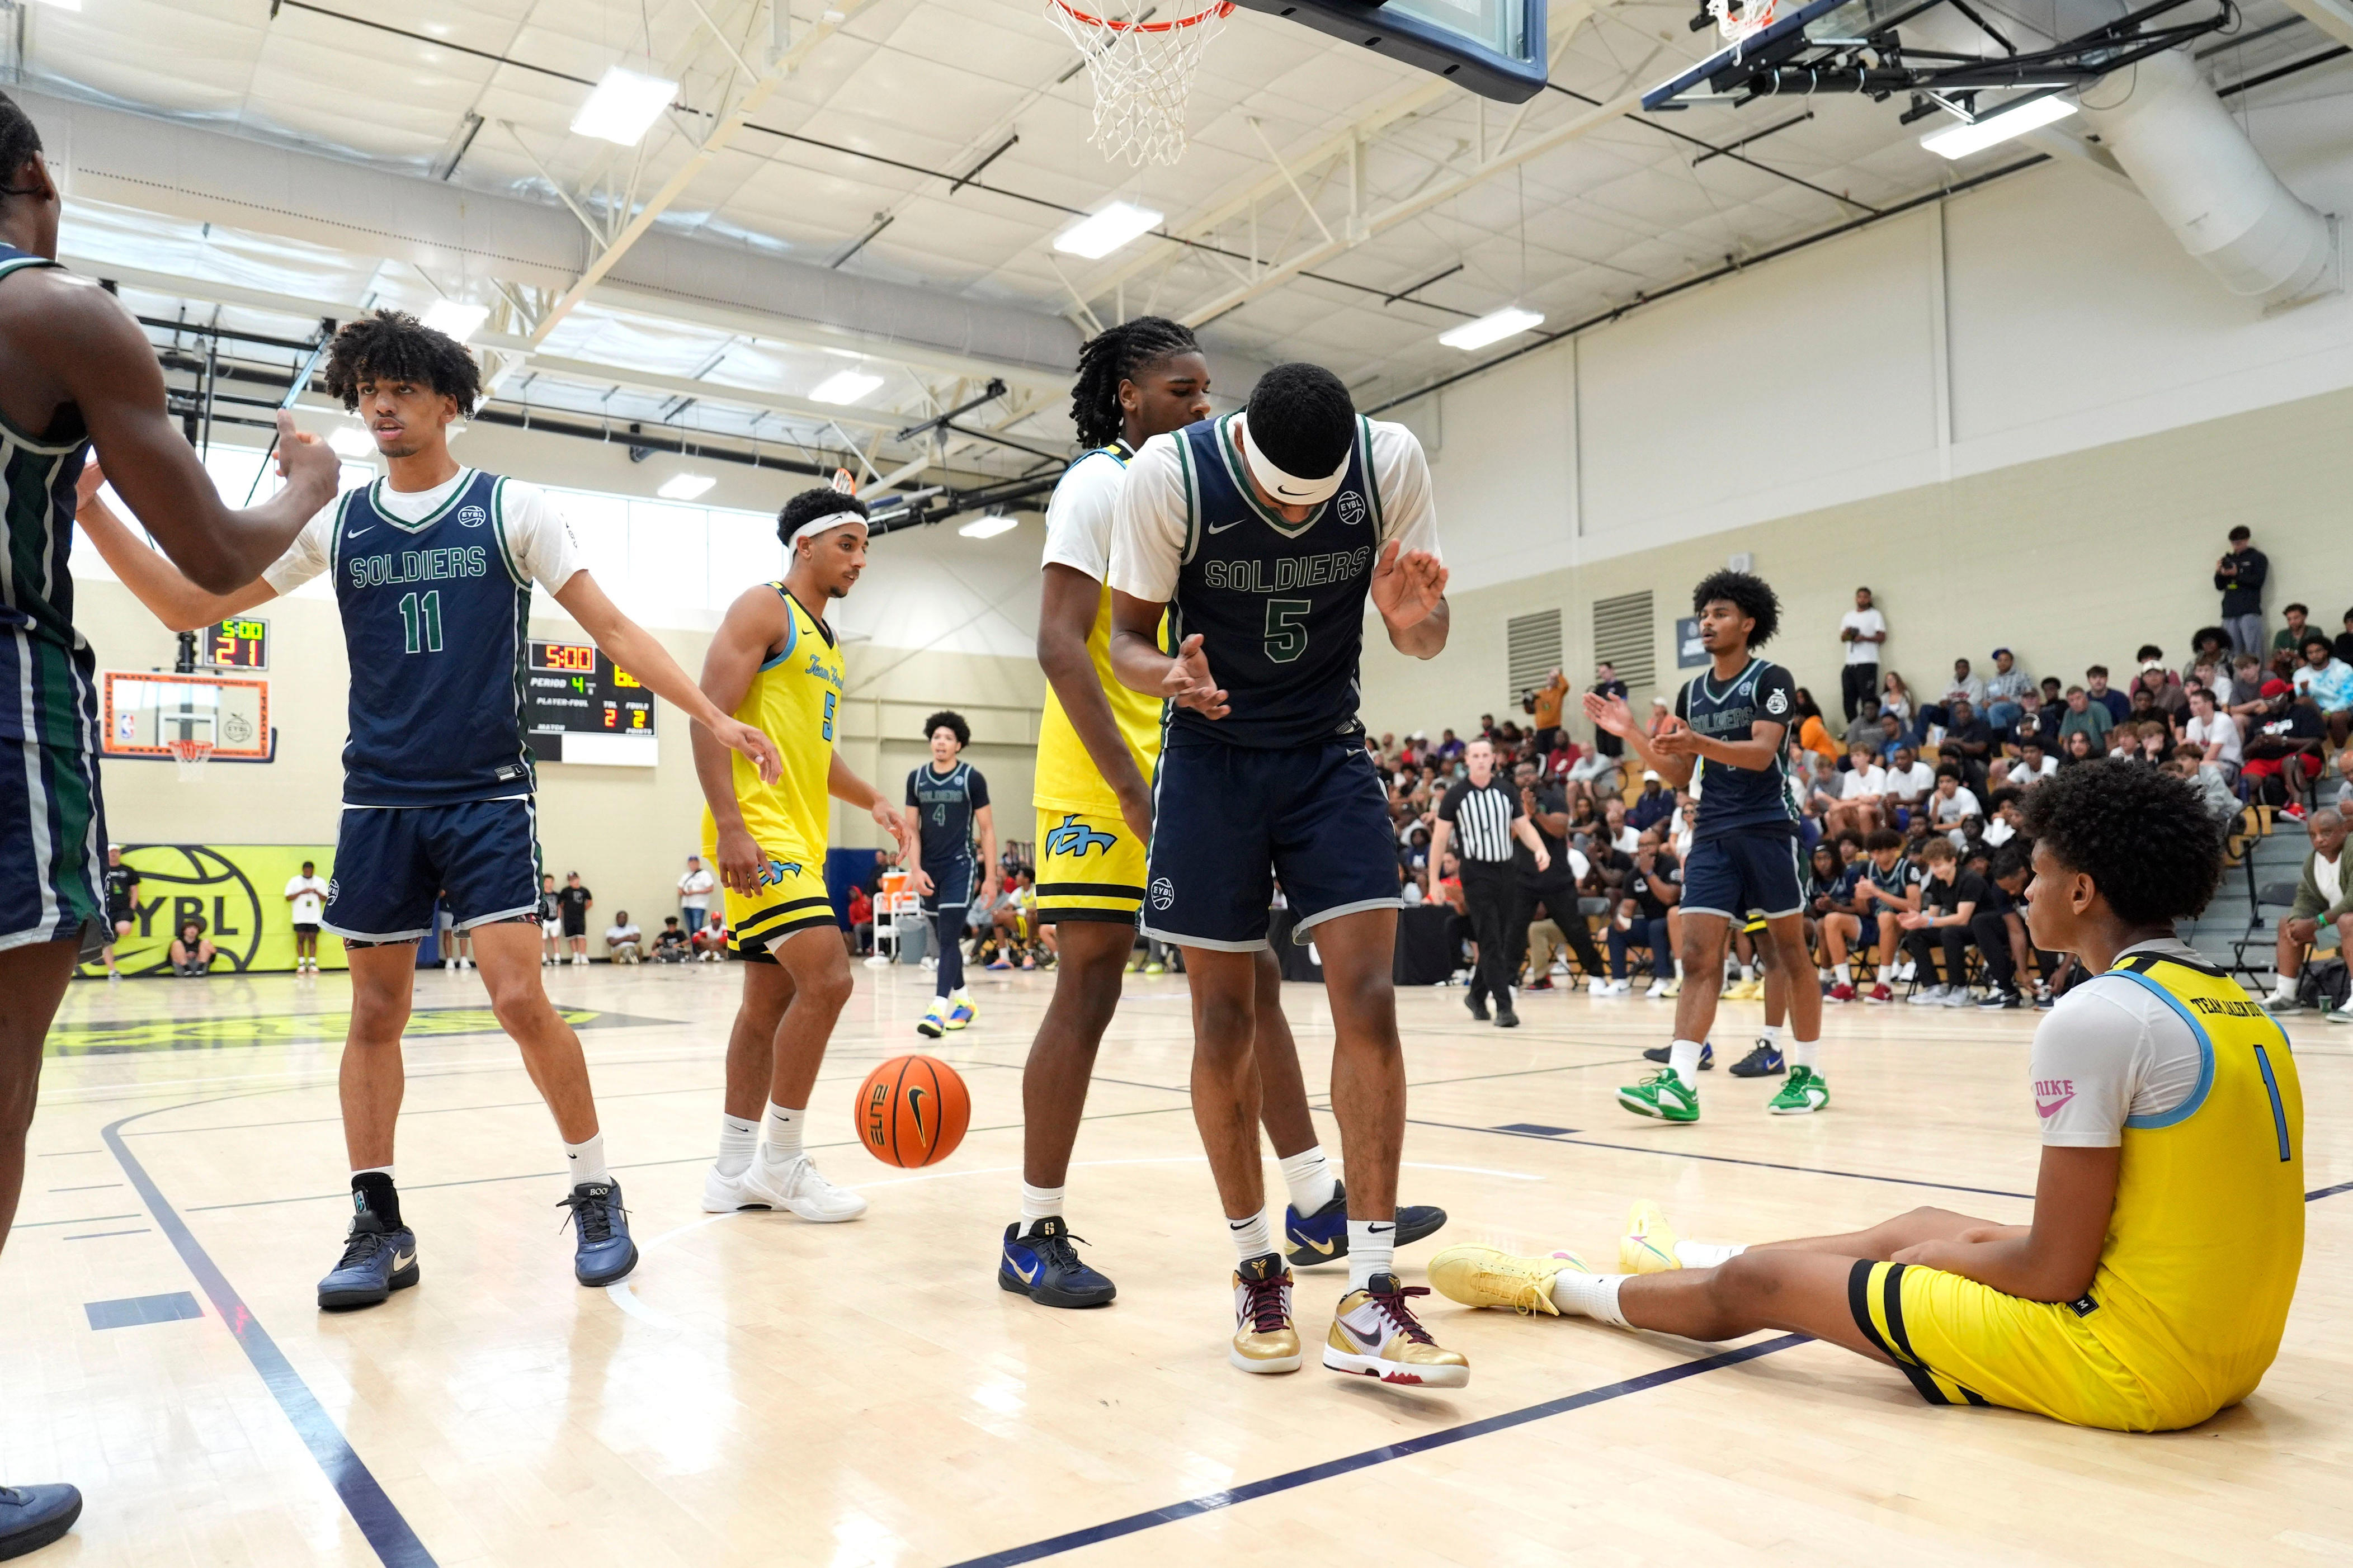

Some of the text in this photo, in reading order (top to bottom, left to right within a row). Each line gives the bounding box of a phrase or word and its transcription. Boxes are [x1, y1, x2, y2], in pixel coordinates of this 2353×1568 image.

[1341, 499, 1362, 511] EYBL
[350, 546, 487, 588] SOLDIERS
[1205, 545, 1370, 592] SOLDIERS
[399, 590, 443, 654] 11
[1265, 599, 1312, 663] 5
[546, 645, 593, 670] 5:00
[805, 654, 829, 681] Team
[530, 677, 567, 689] PERIOD
[572, 676, 584, 694] 4
[605, 709, 617, 728] 2
[625, 702, 649, 711] FOULS
[822, 690, 836, 742] 5
[633, 710, 646, 729] 2
[932, 803, 946, 827] 4
[1153, 886, 1172, 897] EYBL
[135, 896, 238, 937] YBL
[2190, 998, 2227, 1015] TEAM
[2225, 1000, 2251, 1017] JALEN
[2035, 1080, 2074, 1096] NIKE
[869, 1083, 890, 1146] ELITE
[2253, 1044, 2291, 1163] 1
[2077, 1299, 2089, 1309] M
